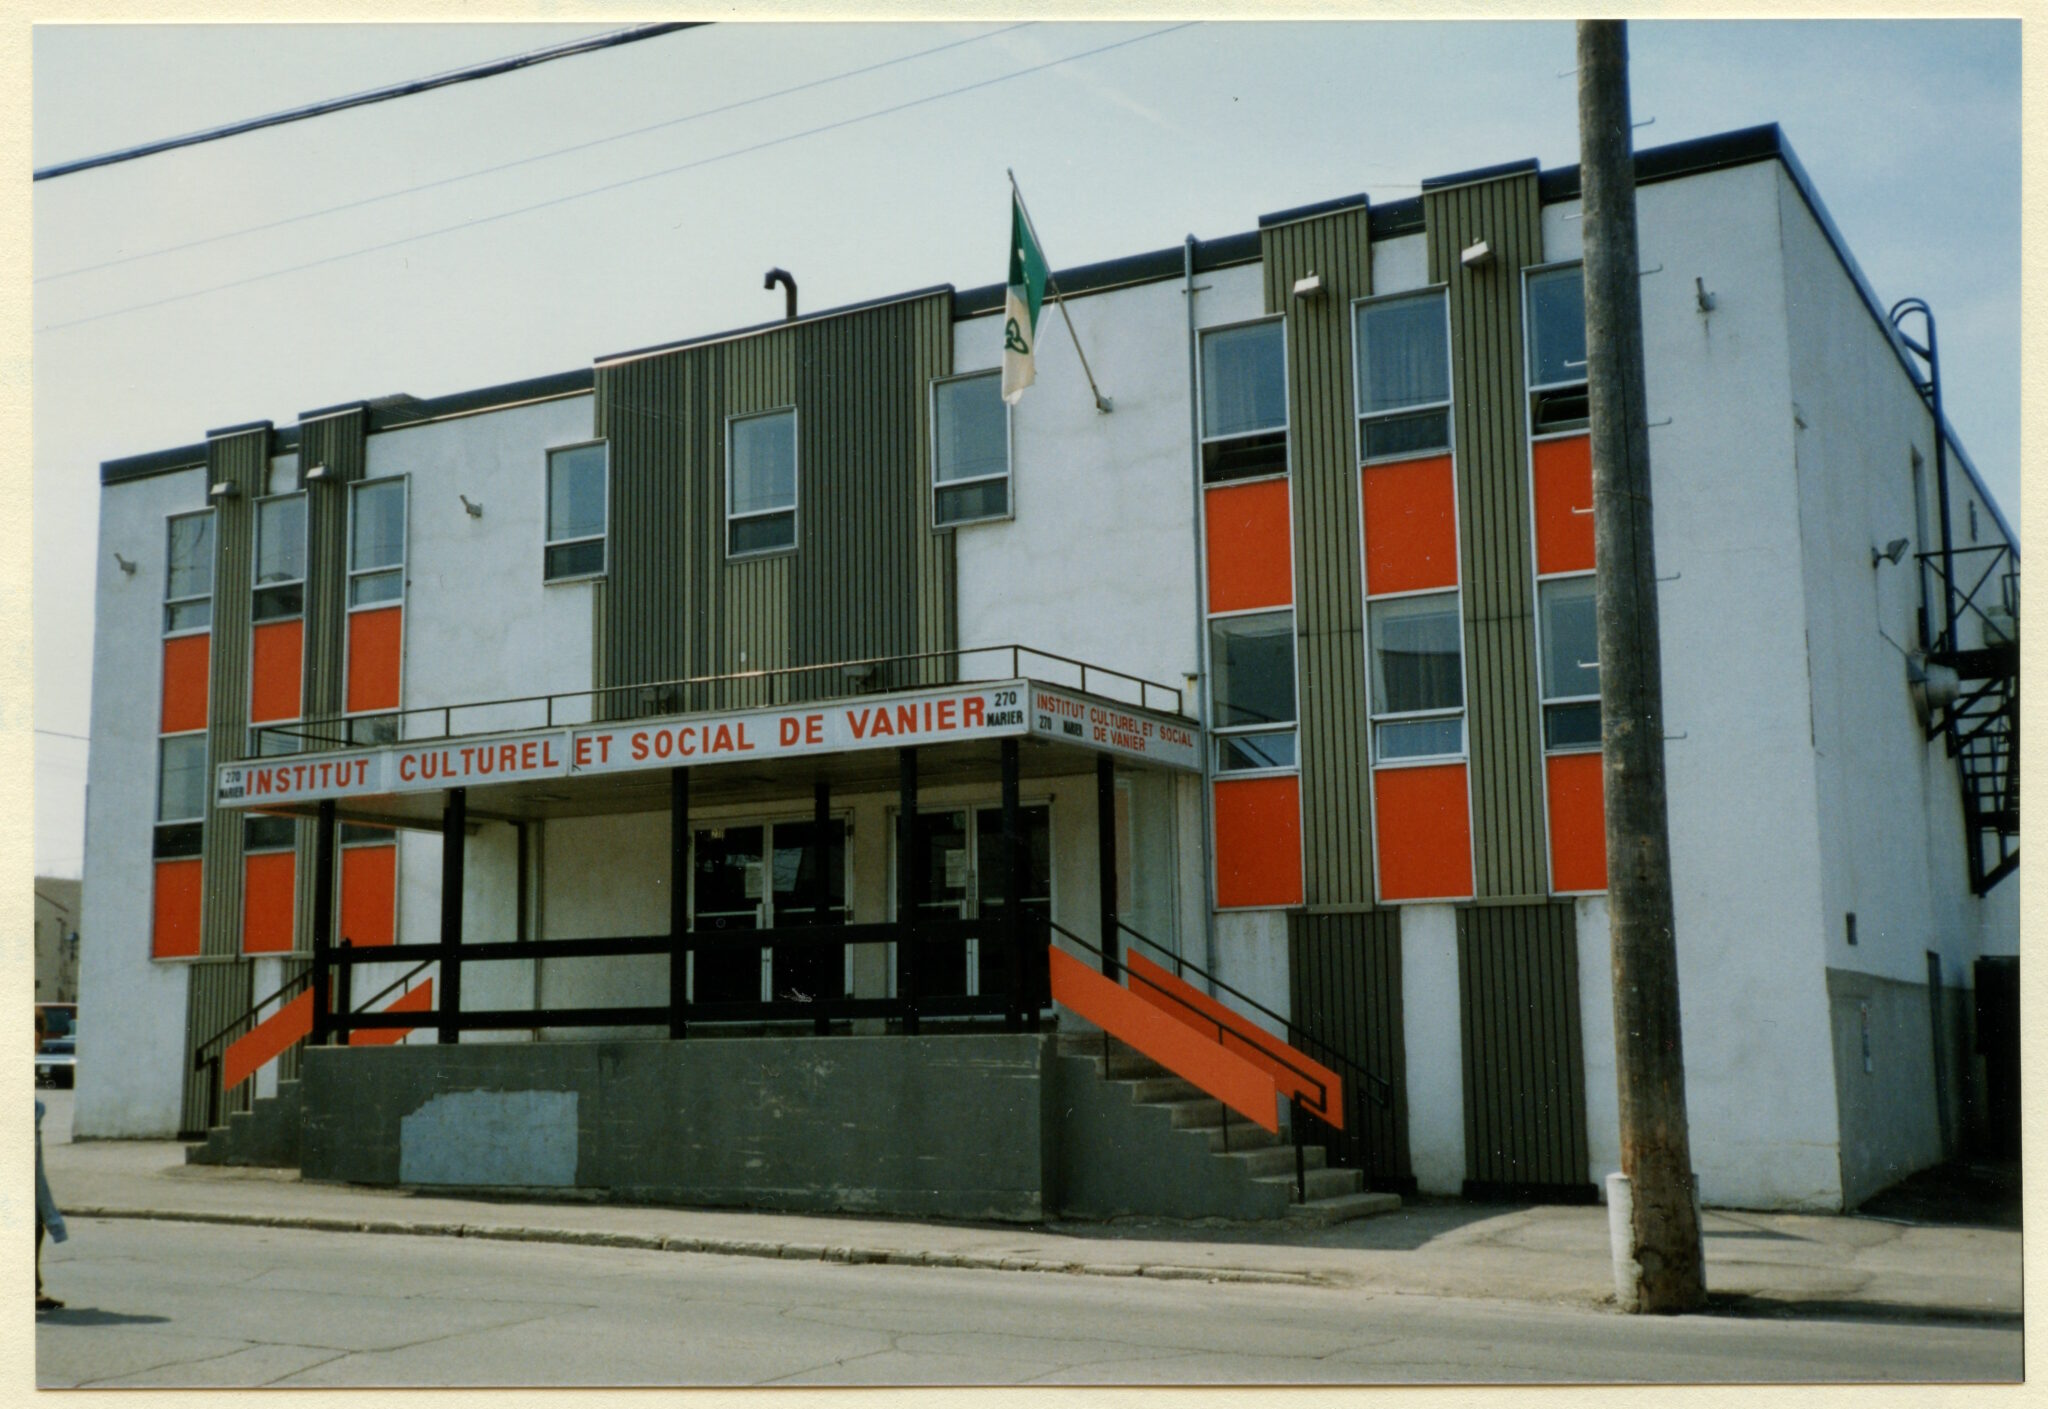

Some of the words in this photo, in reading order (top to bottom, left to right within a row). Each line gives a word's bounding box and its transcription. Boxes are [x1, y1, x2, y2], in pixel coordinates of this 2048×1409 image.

[994, 691, 1017, 707] 270
[986, 710, 1023, 727] MARIER
[1036, 693, 1085, 720] INSTITUT
[1089, 706, 1140, 735] CULTUREL
[1141, 721, 1153, 737] ET
[1159, 725, 1193, 748] SOCIAL
[1039, 715, 1052, 730] 270
[1063, 720, 1083, 737] MARIER
[245, 759, 369, 796] INSTITUT
[399, 742, 559, 782] CULTUREL
[575, 735, 613, 765] ET
[631, 722, 755, 761] SOCIAL
[779, 714, 823, 747] DE
[846, 696, 985, 739] VANIER
[1093, 726, 1107, 742] DE
[1111, 732, 1146, 751] VANIER
[225, 770, 242, 783] 270
[219, 786, 244, 799] MARIER
